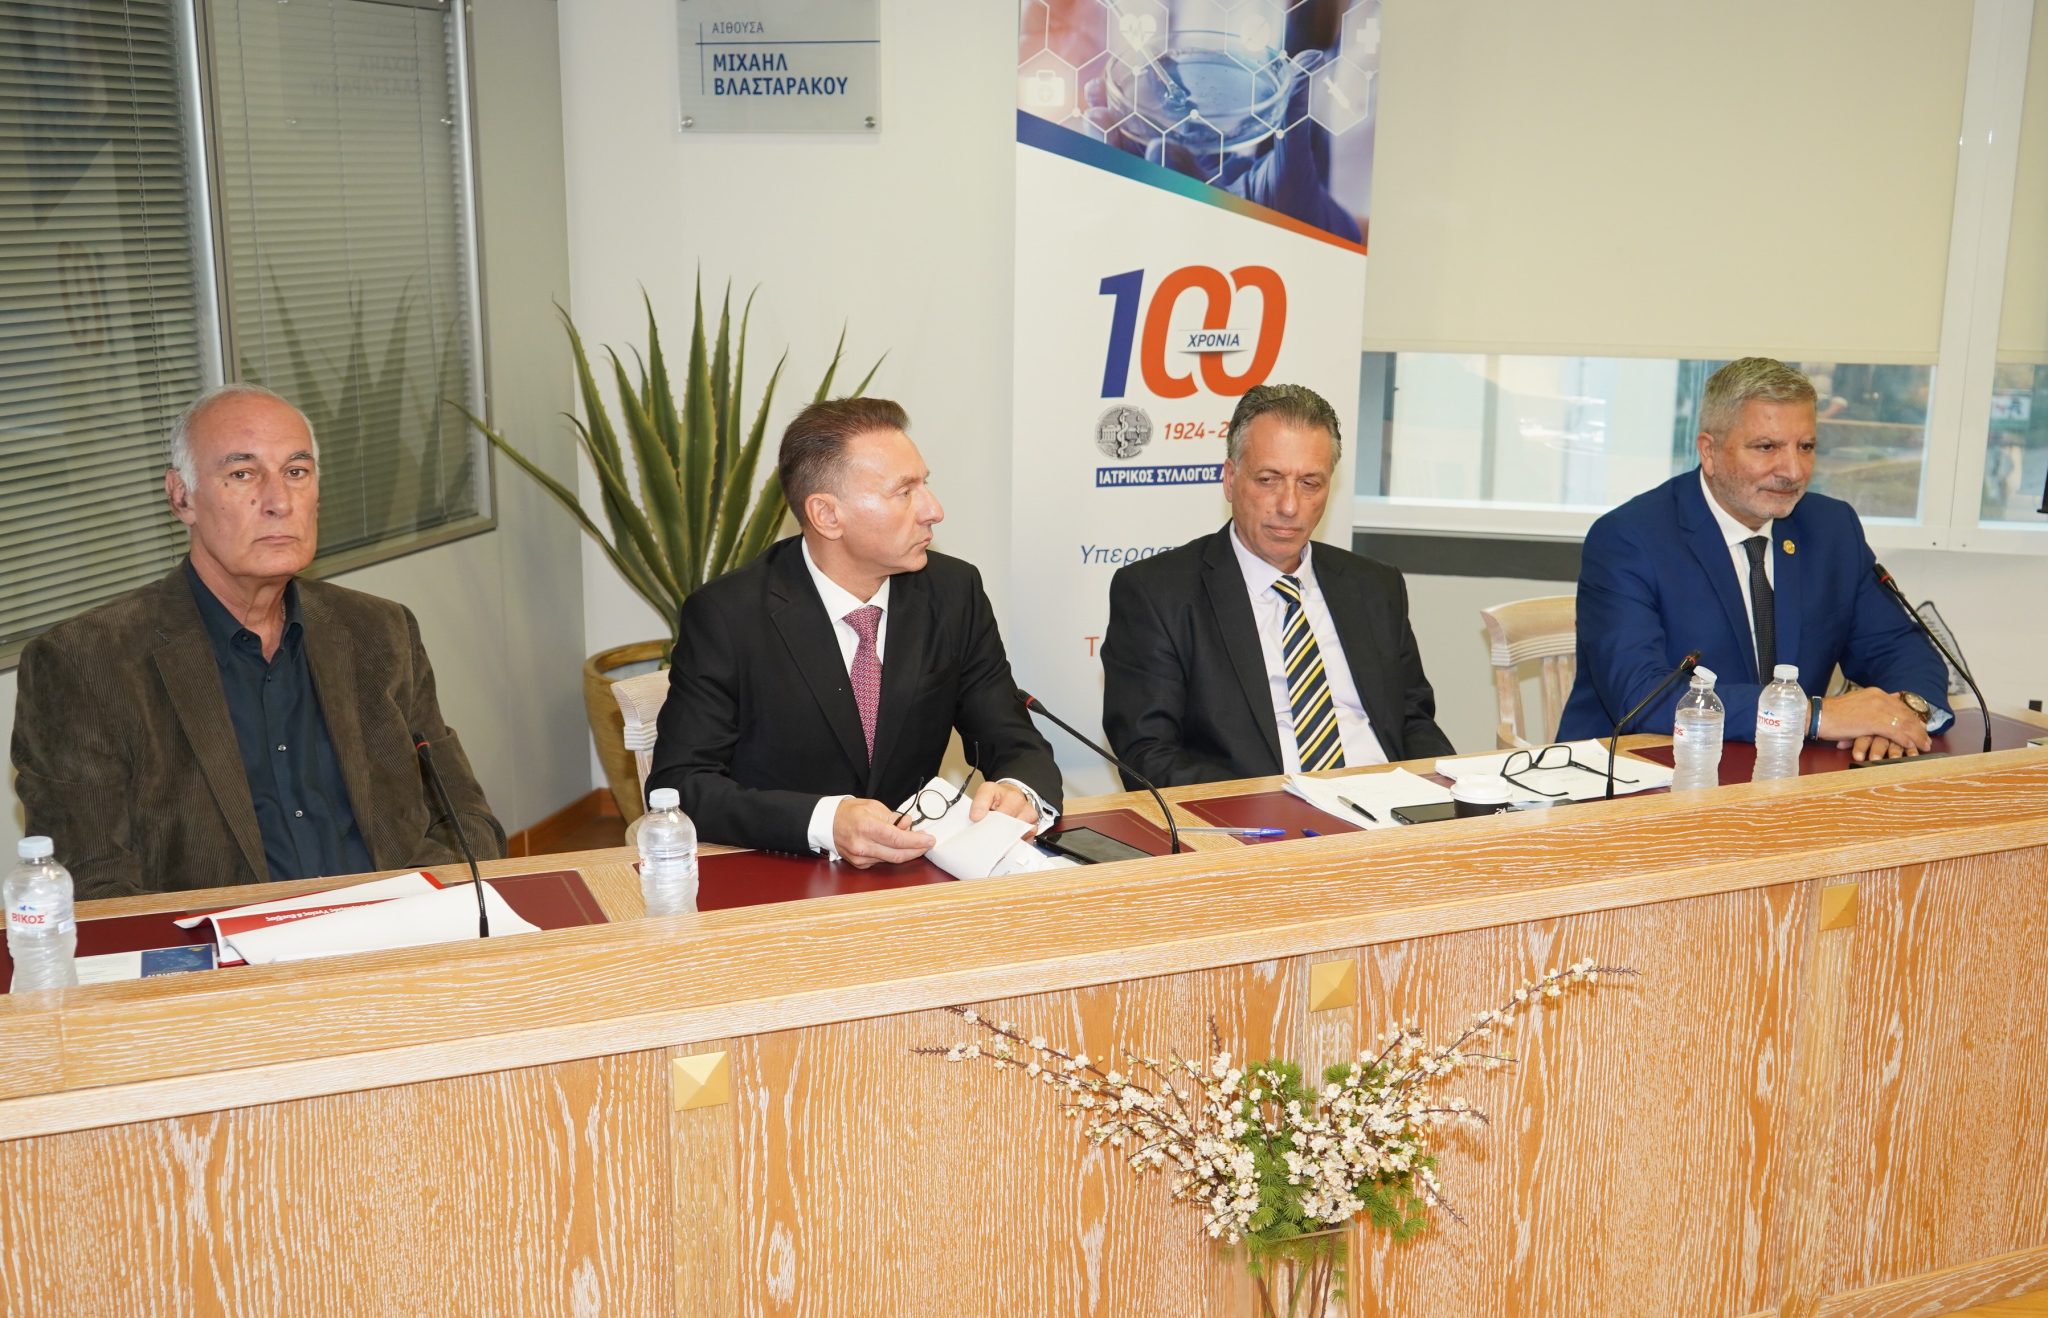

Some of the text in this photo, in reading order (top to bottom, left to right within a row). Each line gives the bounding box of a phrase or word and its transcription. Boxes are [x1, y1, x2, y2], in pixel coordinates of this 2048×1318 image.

[712, 22, 764, 34] ΑΙΘΟΥΣΑ
[713, 53, 788, 72] ΜΙΧΑΗΛ
[714, 77, 848, 96] ΒΛΑΣΤΑΡΑΚΟΥ
[1099, 265, 1287, 399] 100
[1187, 333, 1240, 347] ΧΡΟΝΙΑ
[1164, 421, 1230, 440] 1924-2
[1099, 469, 1154, 484] ΙΑΤΡΙΚΟΣ
[1156, 467, 1217, 482] ΣΥΛΛΟΓΟΣ
[11, 912, 45, 925] ΒΙΚΟΣ
